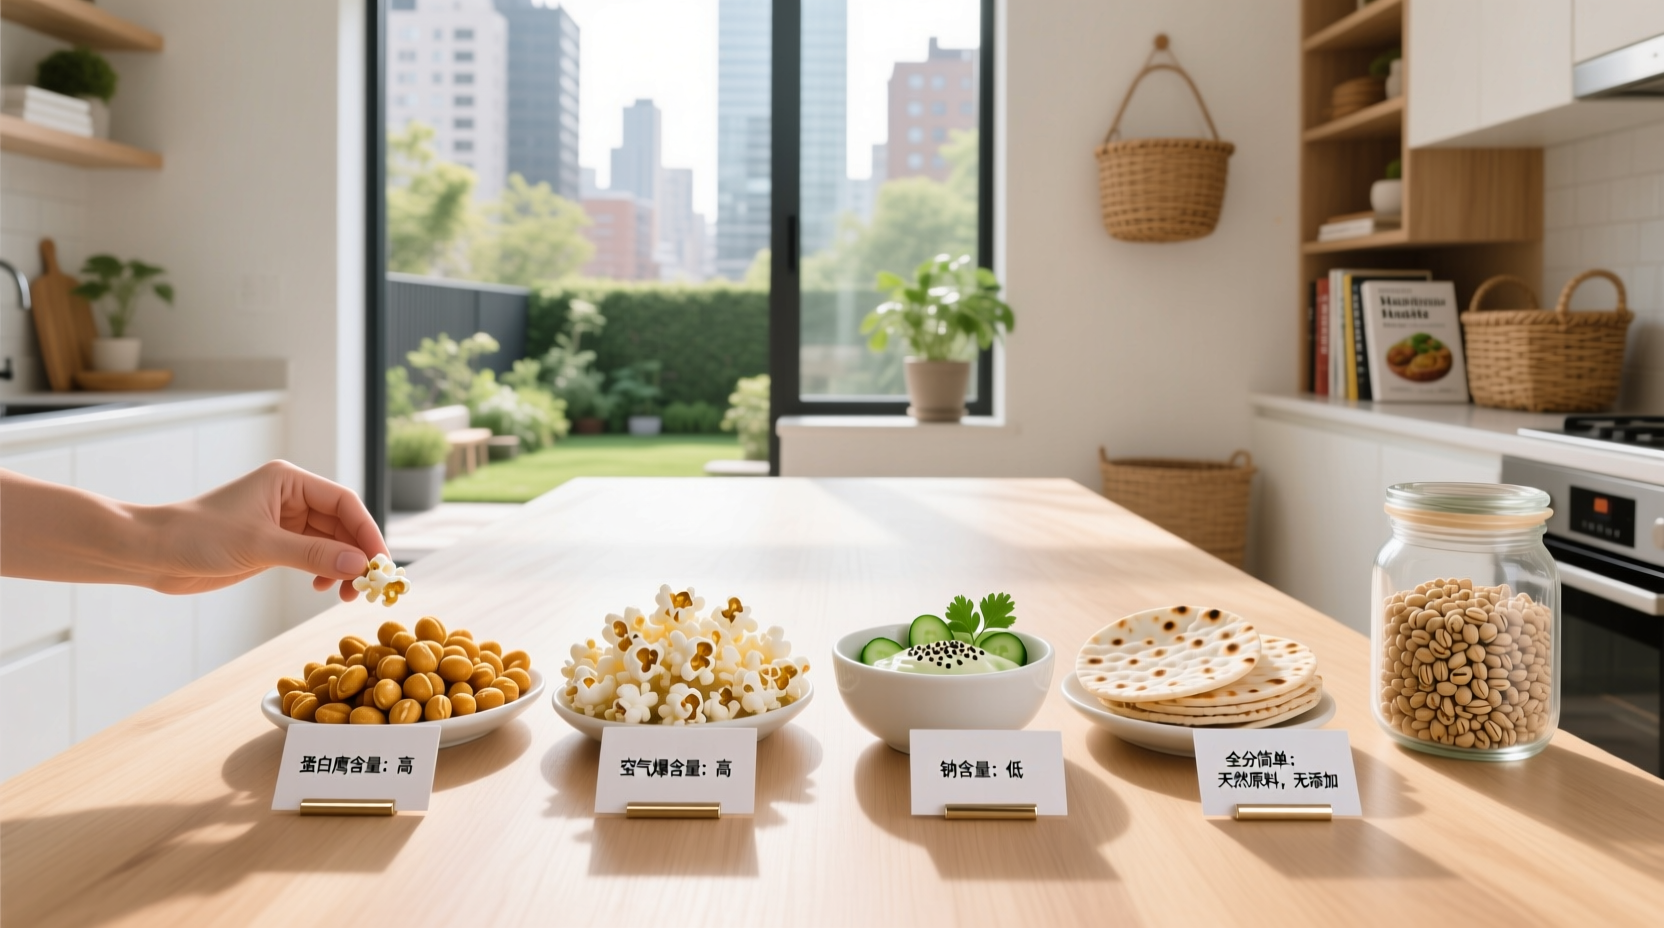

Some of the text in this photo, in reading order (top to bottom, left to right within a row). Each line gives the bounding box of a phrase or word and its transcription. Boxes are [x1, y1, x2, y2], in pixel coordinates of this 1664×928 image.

[939, 760, 1025, 779] 钠含量：低
[1217, 770, 1339, 790] 天然原料，无添加
